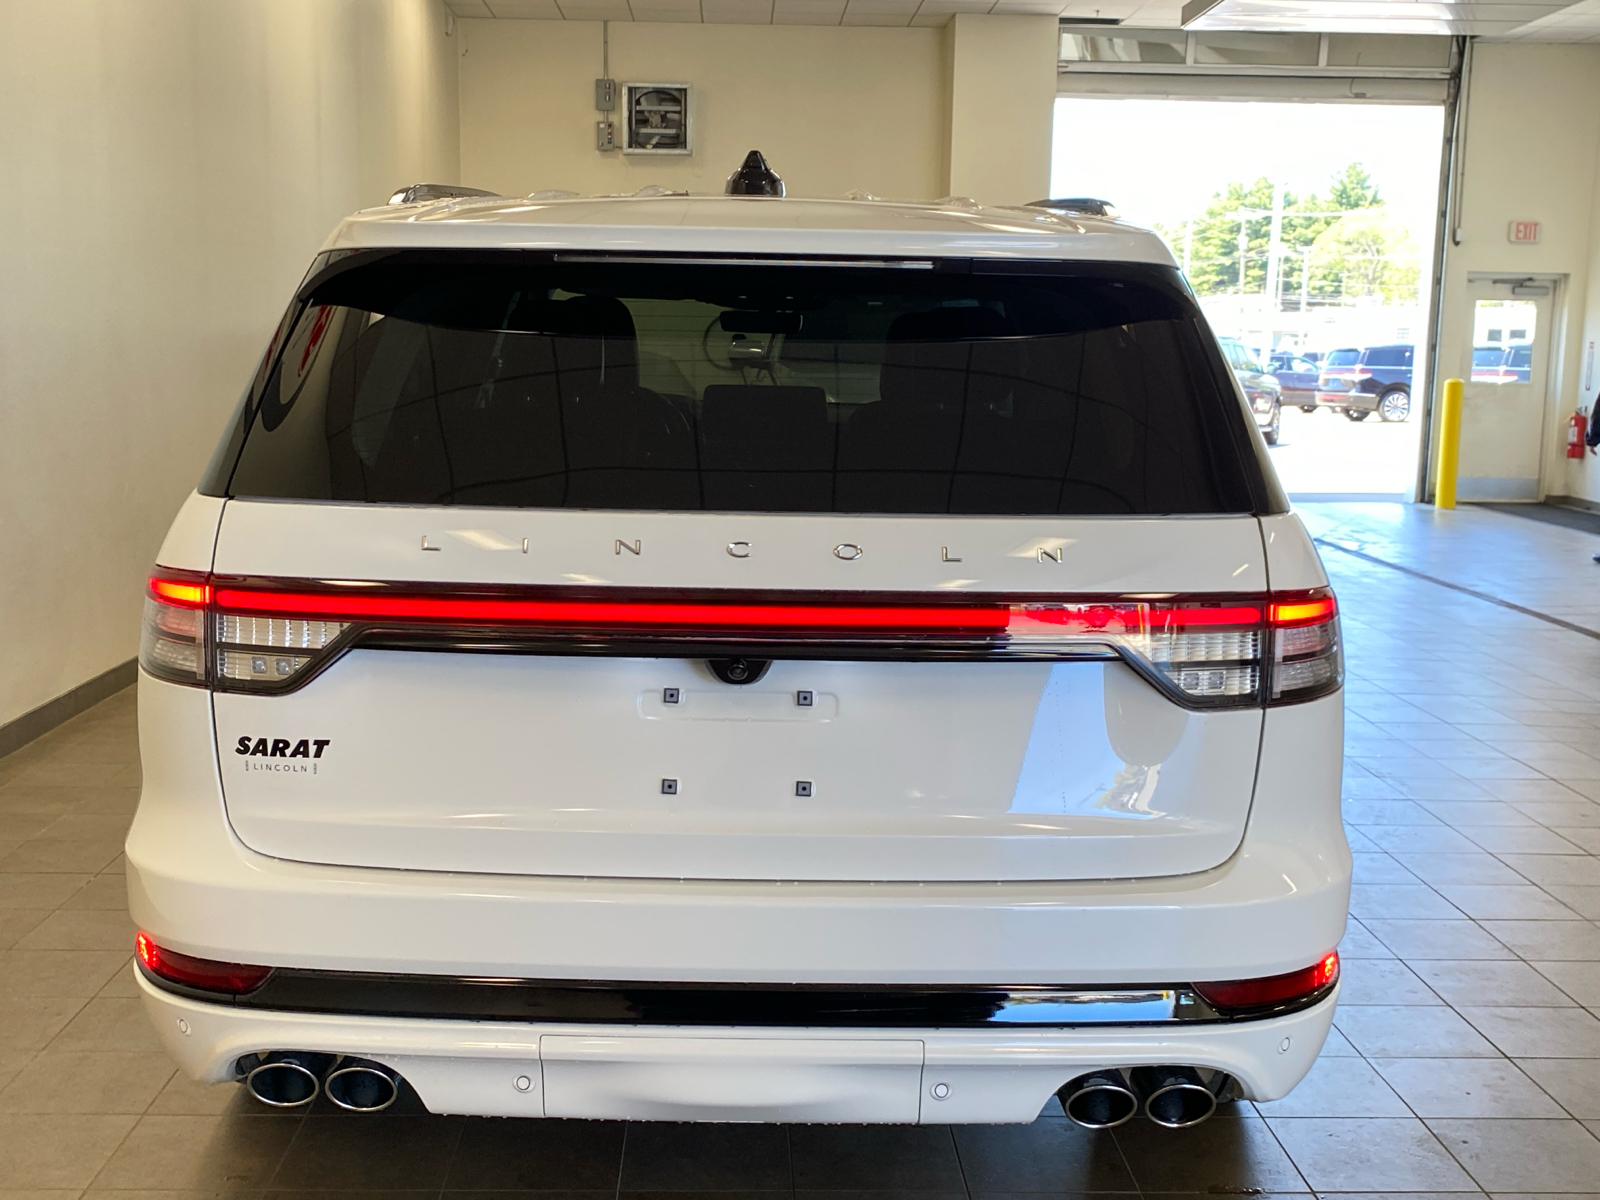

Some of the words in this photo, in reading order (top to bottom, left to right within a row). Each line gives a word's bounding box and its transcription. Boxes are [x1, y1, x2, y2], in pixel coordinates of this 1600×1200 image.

[1515, 221, 1539, 241] EXIT
[421, 535, 1064, 564] LINCOLN
[234, 735, 331, 758] SARAT
[252, 762, 308, 773] LINCOLN
